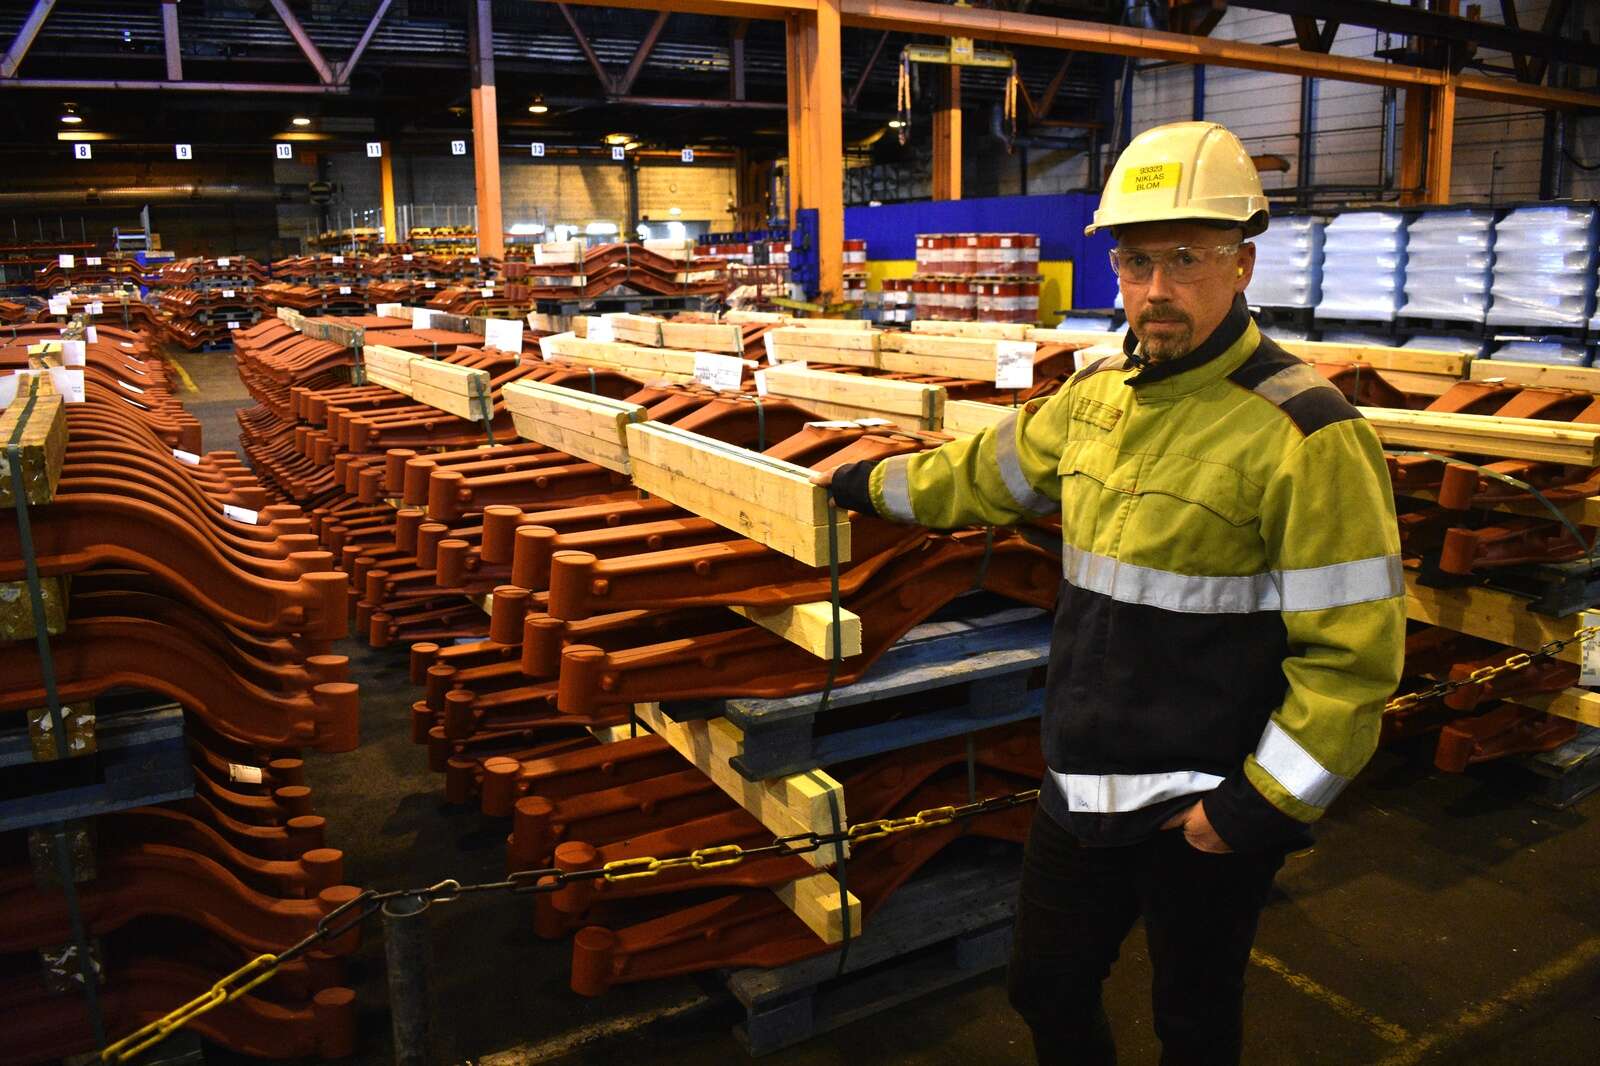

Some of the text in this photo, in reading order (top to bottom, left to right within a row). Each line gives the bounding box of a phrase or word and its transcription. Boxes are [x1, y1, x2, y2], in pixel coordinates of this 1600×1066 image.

[80, 146, 86, 157] 8
[180, 146, 187, 157] 9
[278, 146, 290, 156] 10
[369, 144, 380, 155] 11
[453, 142, 464, 153] 12
[533, 144, 543, 155] 13
[614, 148, 623, 158] 14
[683, 151, 692, 161] 15
[1135, 173, 1165, 183] NIKLAS
[1136, 182, 1160, 191] BLOM
